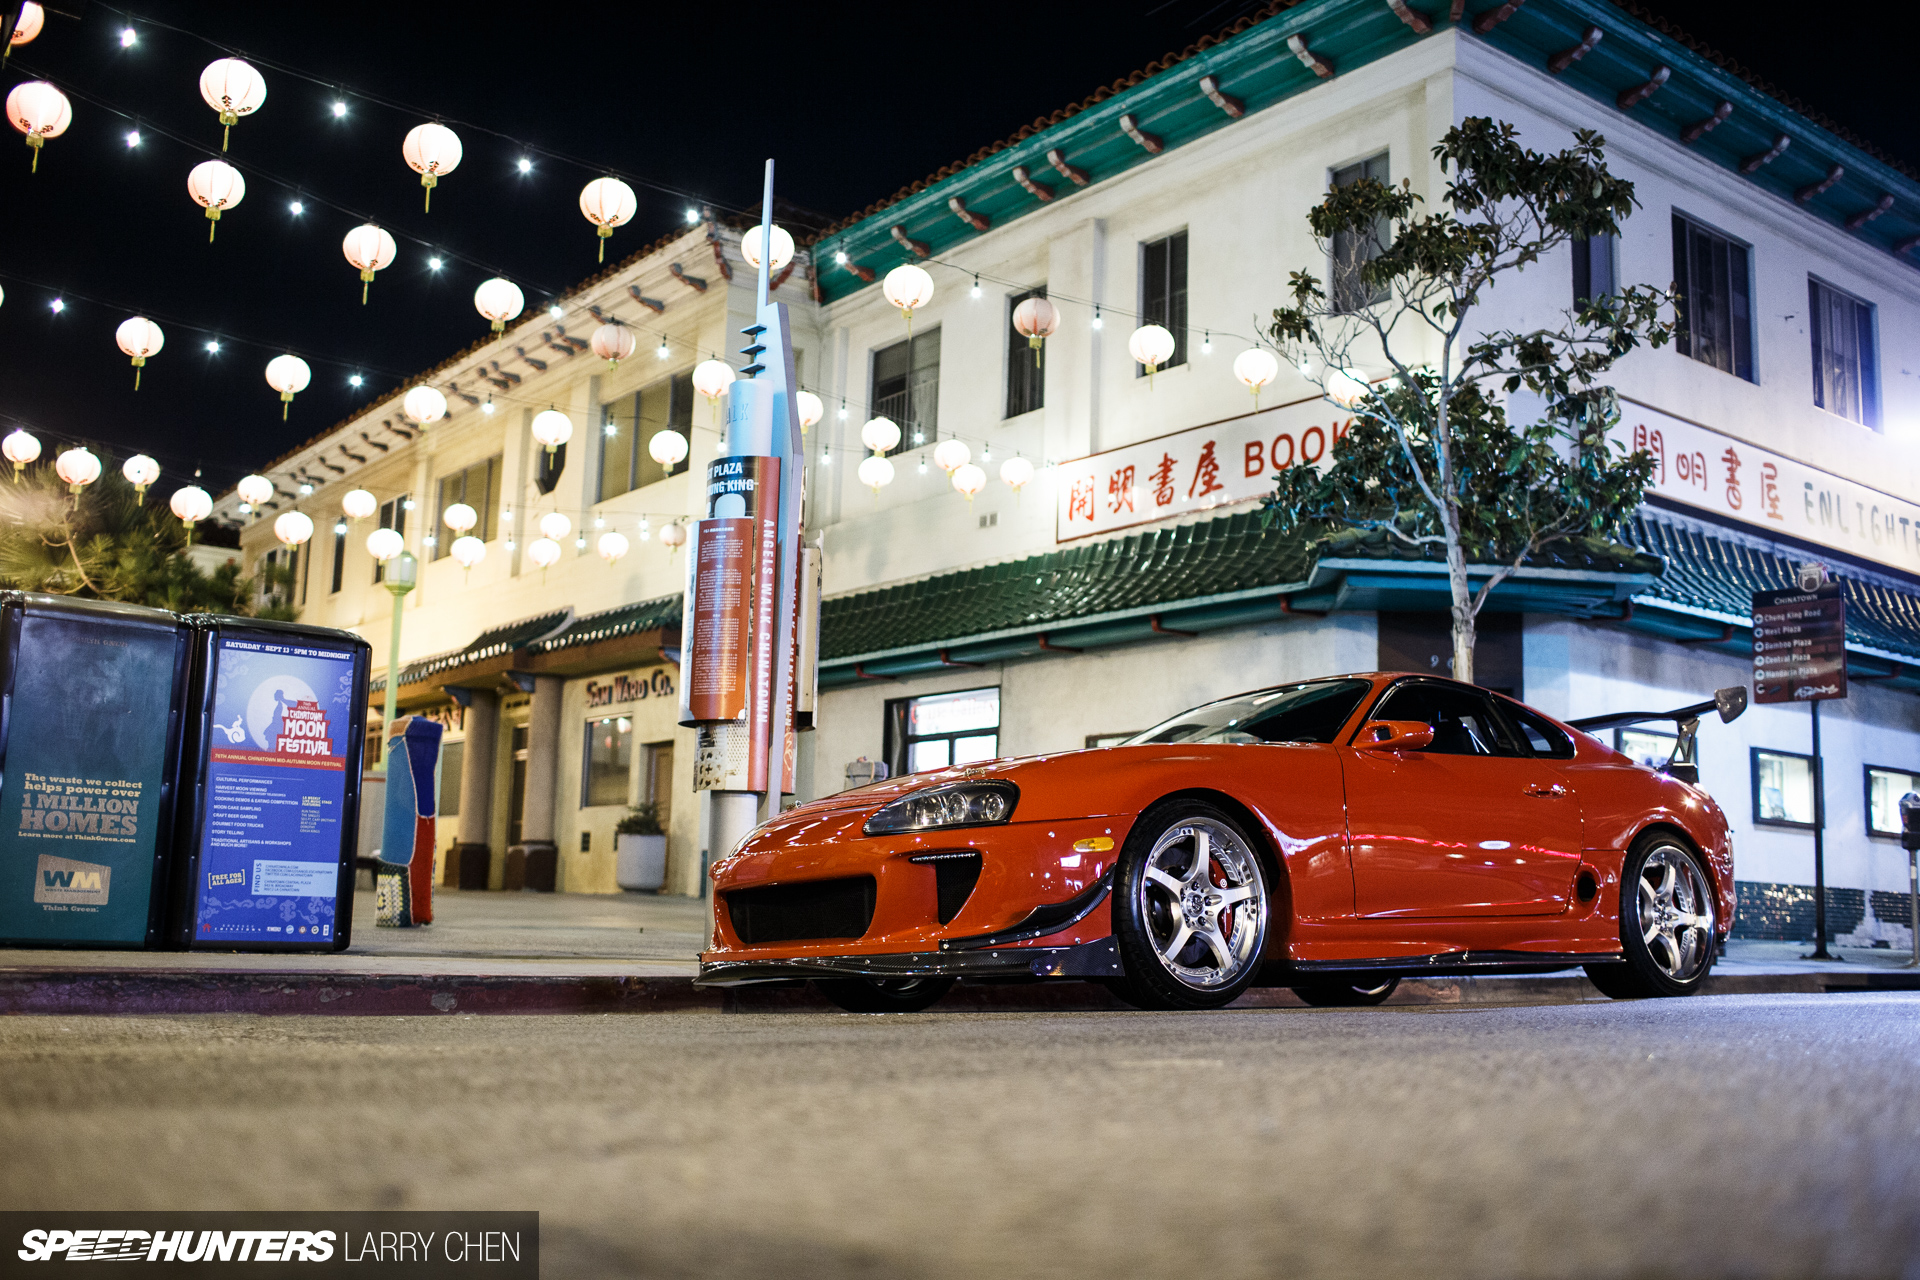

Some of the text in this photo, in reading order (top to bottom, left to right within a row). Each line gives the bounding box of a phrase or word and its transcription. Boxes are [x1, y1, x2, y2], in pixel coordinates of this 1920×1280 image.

[713, 462, 743, 478] PLAZA
[727, 479, 754, 492] KING
[757, 519, 775, 723] ANGELS WALK CHINATOWN
[225, 641, 261, 650] SATURDAY
[318, 651, 350, 660] MIDNIGHT
[1793, 639, 1812, 647] Plaza
[1792, 653, 1811, 661] Plaza
[289, 710, 323, 721] CHINATOWN
[284, 719, 326, 739] MOON
[278, 737, 331, 756] FESTIVAL
[25, 772, 46, 781] The
[49, 776, 83, 785] waste
[105, 780, 142, 789] collect
[24, 781, 141, 797] helps power over
[22, 793, 139, 815] 1 MILLION
[19, 808, 138, 836] HOMES
[74, 834, 136, 843] ThinkGreen.com
[256, 862, 262, 873] US
[43, 870, 101, 889] WM
